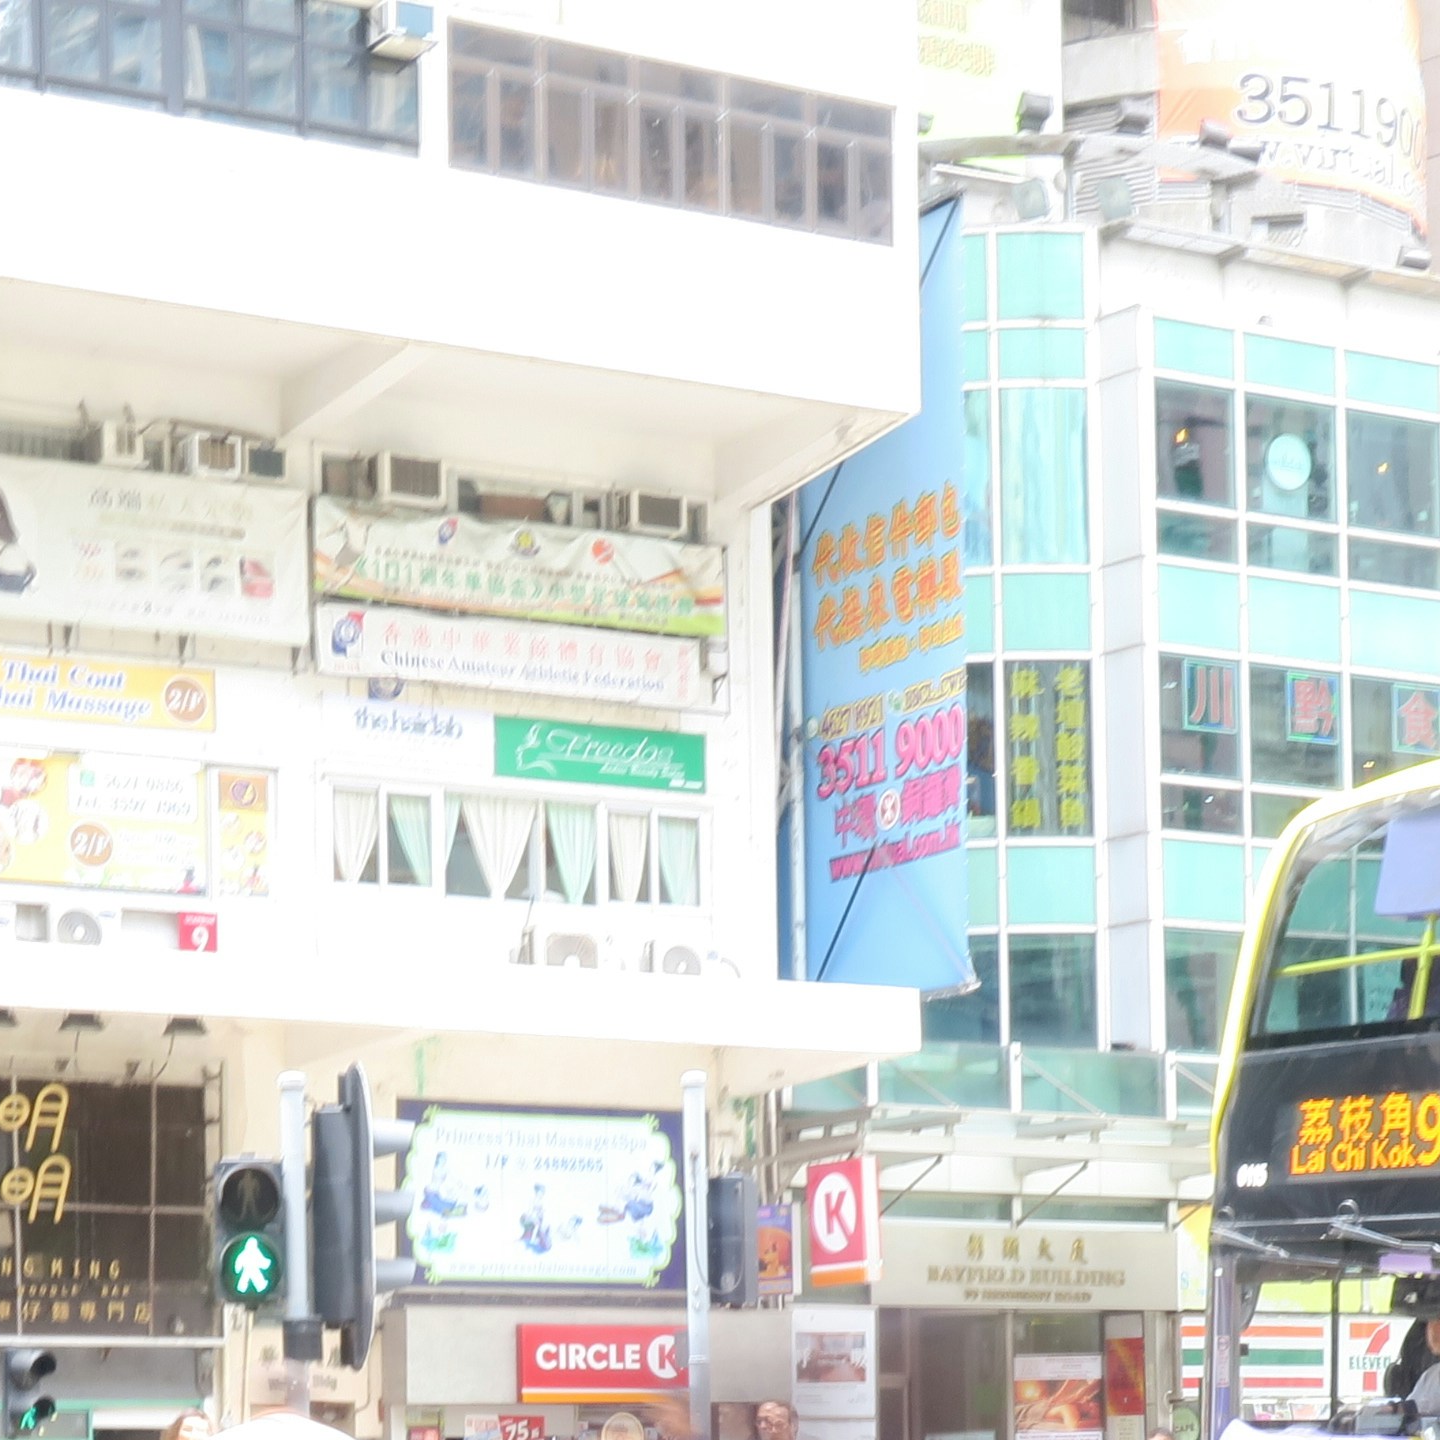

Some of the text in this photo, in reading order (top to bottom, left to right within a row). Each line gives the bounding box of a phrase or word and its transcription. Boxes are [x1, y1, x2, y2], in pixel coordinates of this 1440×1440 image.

[1, 659, 58, 686] Thai
[380, 650, 445, 672] Chinese
[448, 654, 517, 679] Amateur
[583, 665, 665, 693] Federation
[44, 690, 151, 724] Massage
[816, 703, 965, 801] 3511 9000
[1298, 1091, 1413, 1146] 荔枝角
[1290, 1138, 1417, 1176] Lai Chi Kok
[535, 1342, 641, 1371] CIRCLE
